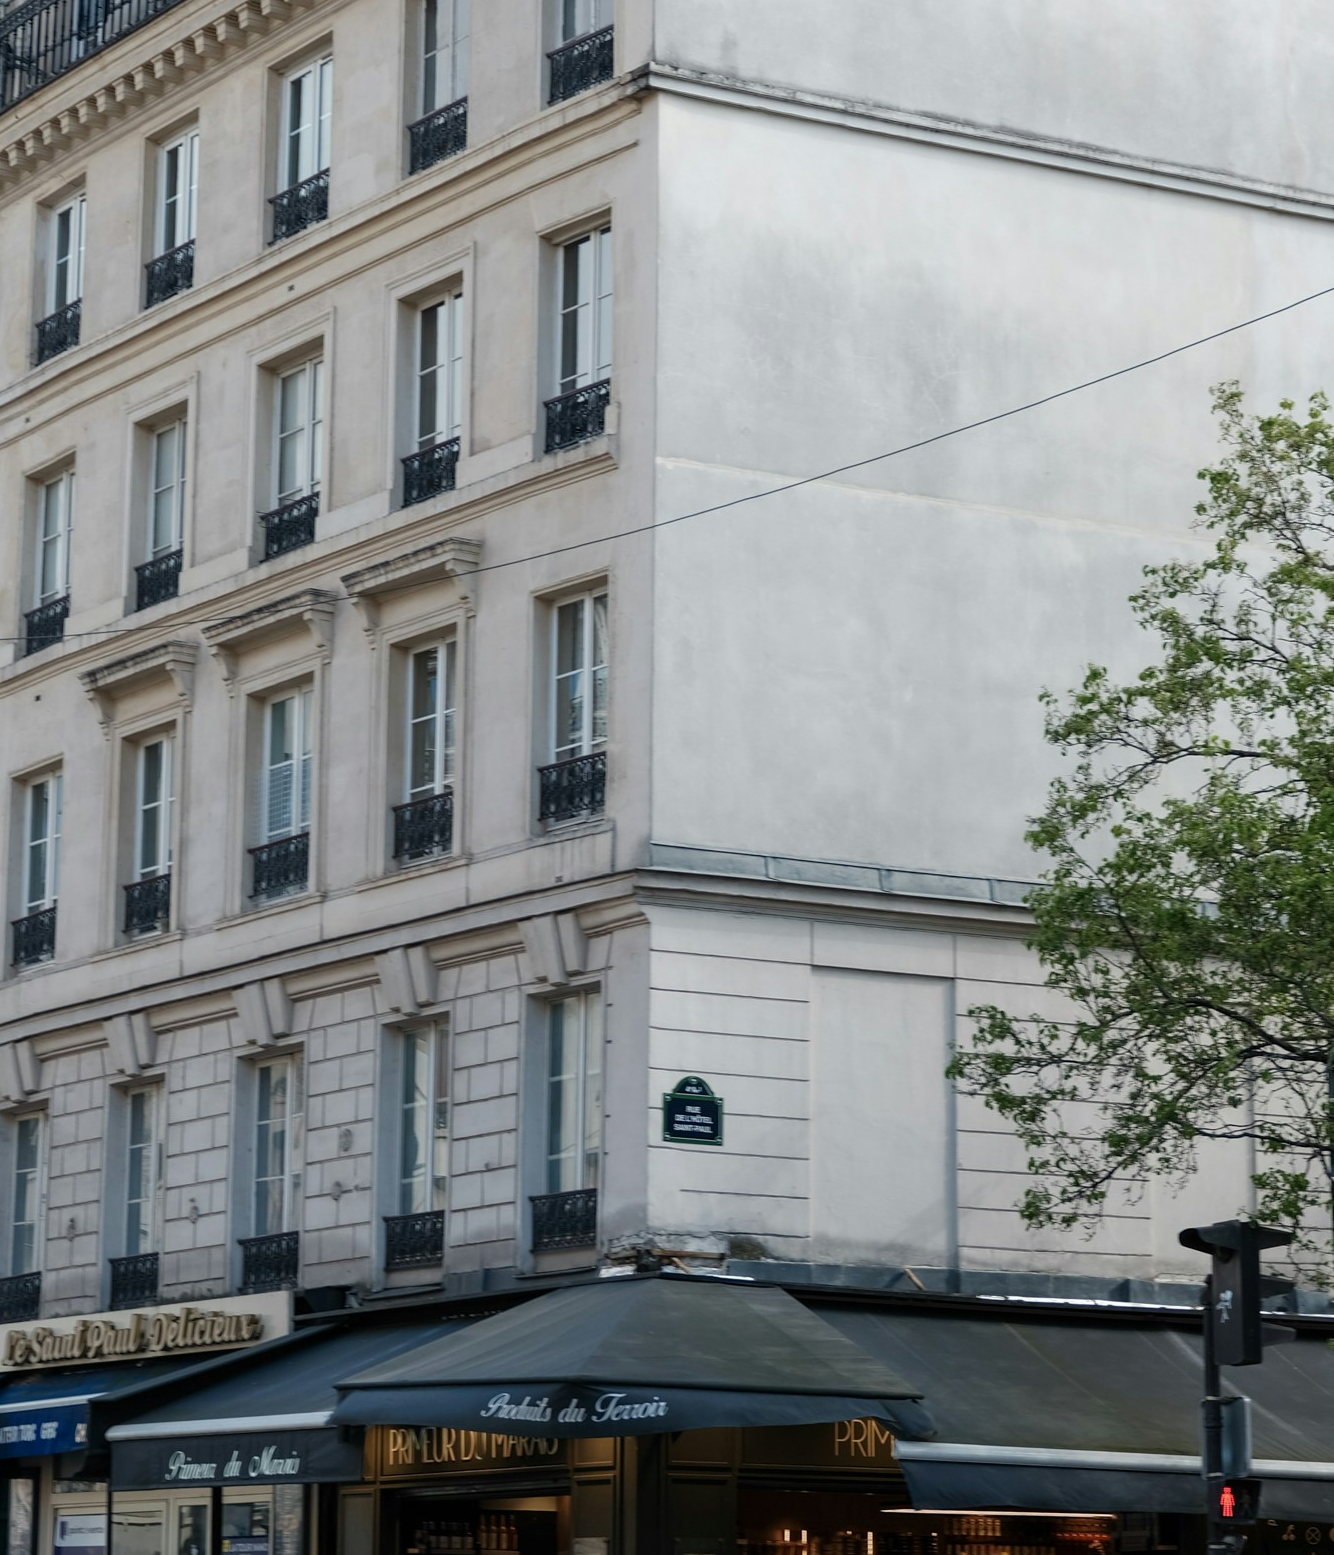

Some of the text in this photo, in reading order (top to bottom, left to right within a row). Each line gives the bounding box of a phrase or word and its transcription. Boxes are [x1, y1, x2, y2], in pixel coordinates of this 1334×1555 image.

[1, 1329, 28, 1366] Le
[27, 1319, 87, 1363] Saint
[86, 1312, 147, 1358] Paul
[481, 1392, 669, 1423] Produits du Terroir
[387, 1428, 560, 1466] PRIMEUR DU MARAIS
[166, 1450, 216, 1480] Primeur
[223, 1449, 241, 1478] du
